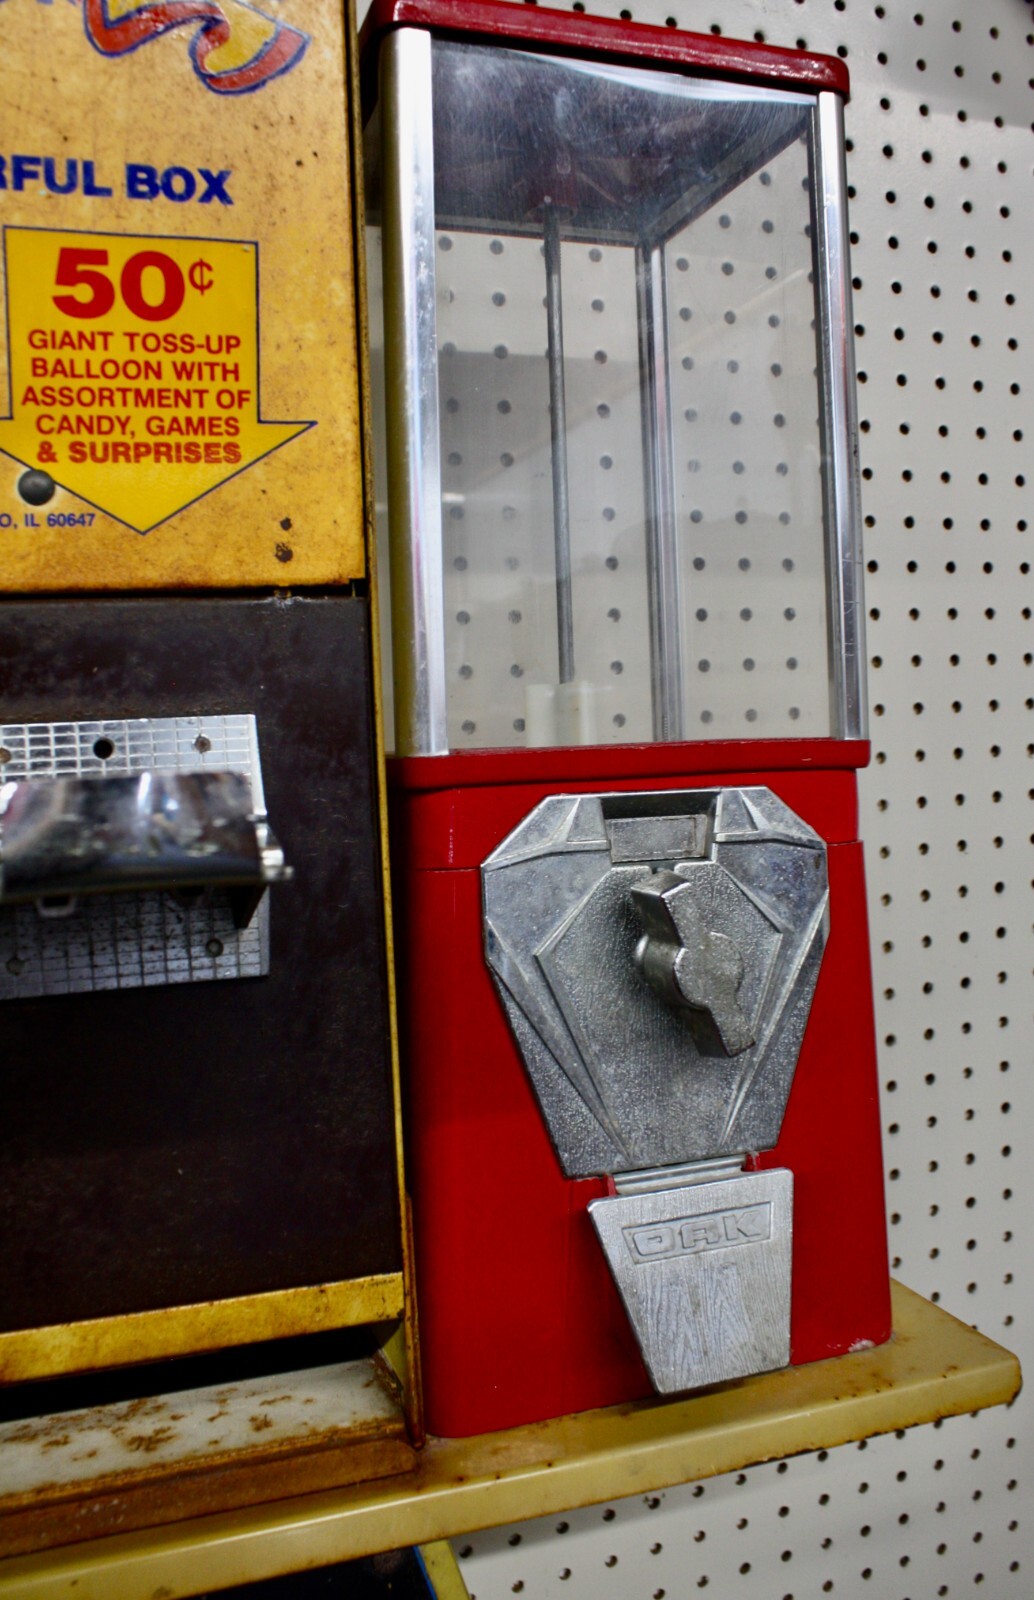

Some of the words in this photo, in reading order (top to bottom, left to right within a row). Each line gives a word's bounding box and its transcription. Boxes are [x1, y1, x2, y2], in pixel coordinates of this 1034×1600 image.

[0, 154, 112, 197] FUL
[125, 163, 234, 205] BOX
[28, 329, 114, 352] GIANT
[123, 332, 241, 355] TOSS-UP
[31, 358, 162, 380] BALLOON
[172, 361, 240, 382] WITH
[21, 386, 209, 408] ASSORTMENT
[216, 389, 251, 410] OF
[35, 414, 136, 439] CANDY,
[145, 416, 240, 437] GAMES
[36, 441, 58, 463] &
[68, 441, 242, 464] SURPRISES
[24, 514, 40, 527] IL
[47, 513, 96, 527] 60647
[632, 1209, 763, 1257] OAK
